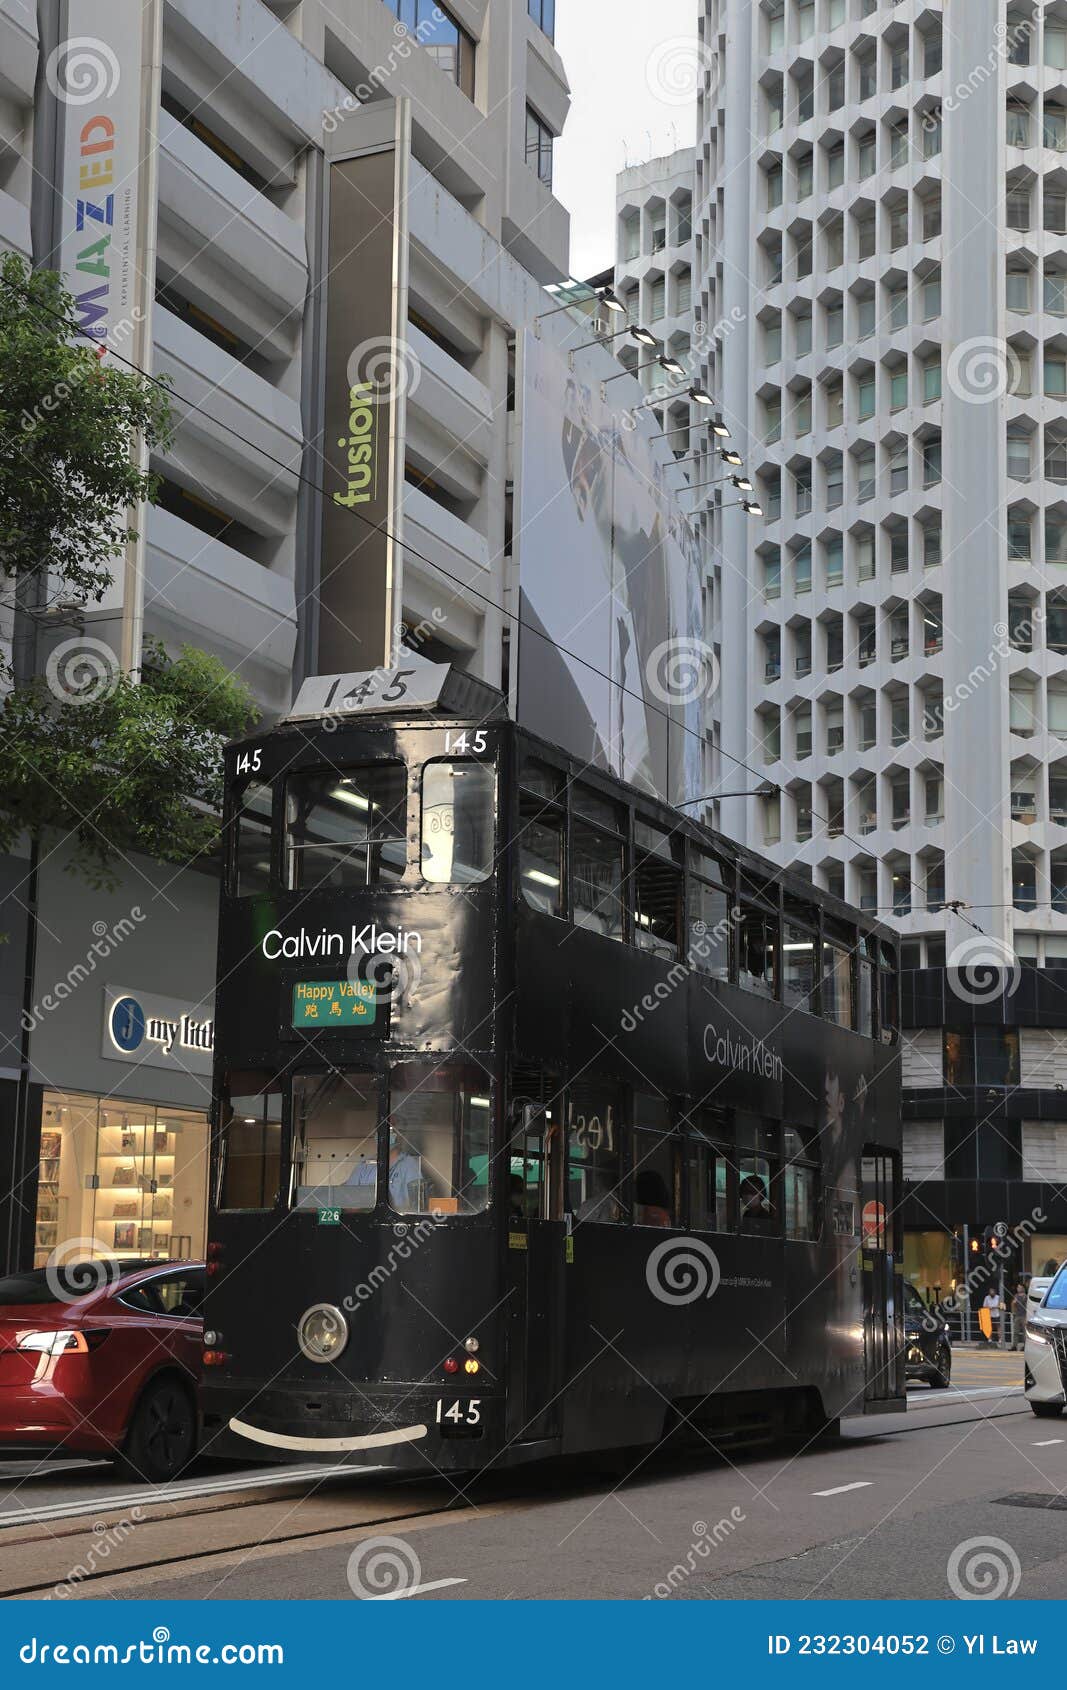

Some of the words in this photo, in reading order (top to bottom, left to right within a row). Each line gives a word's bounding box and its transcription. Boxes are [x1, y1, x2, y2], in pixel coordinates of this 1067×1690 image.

[75, 114, 115, 384] MAZED
[332, 382, 374, 508] fusion
[324, 670, 417, 709] 145
[445, 730, 488, 754] 145
[236, 748, 263, 776] 145
[262, 927, 344, 960] Calvin
[351, 924, 422, 955] Klein
[297, 983, 335, 1001] Happy
[339, 981, 376, 998] Valley
[146, 1018, 180, 1055] my
[703, 1023, 750, 1073] Calvin
[752, 1036, 783, 1082] Klein
[320, 1210, 340, 1222] Z26
[435, 1399, 481, 1425] 145
